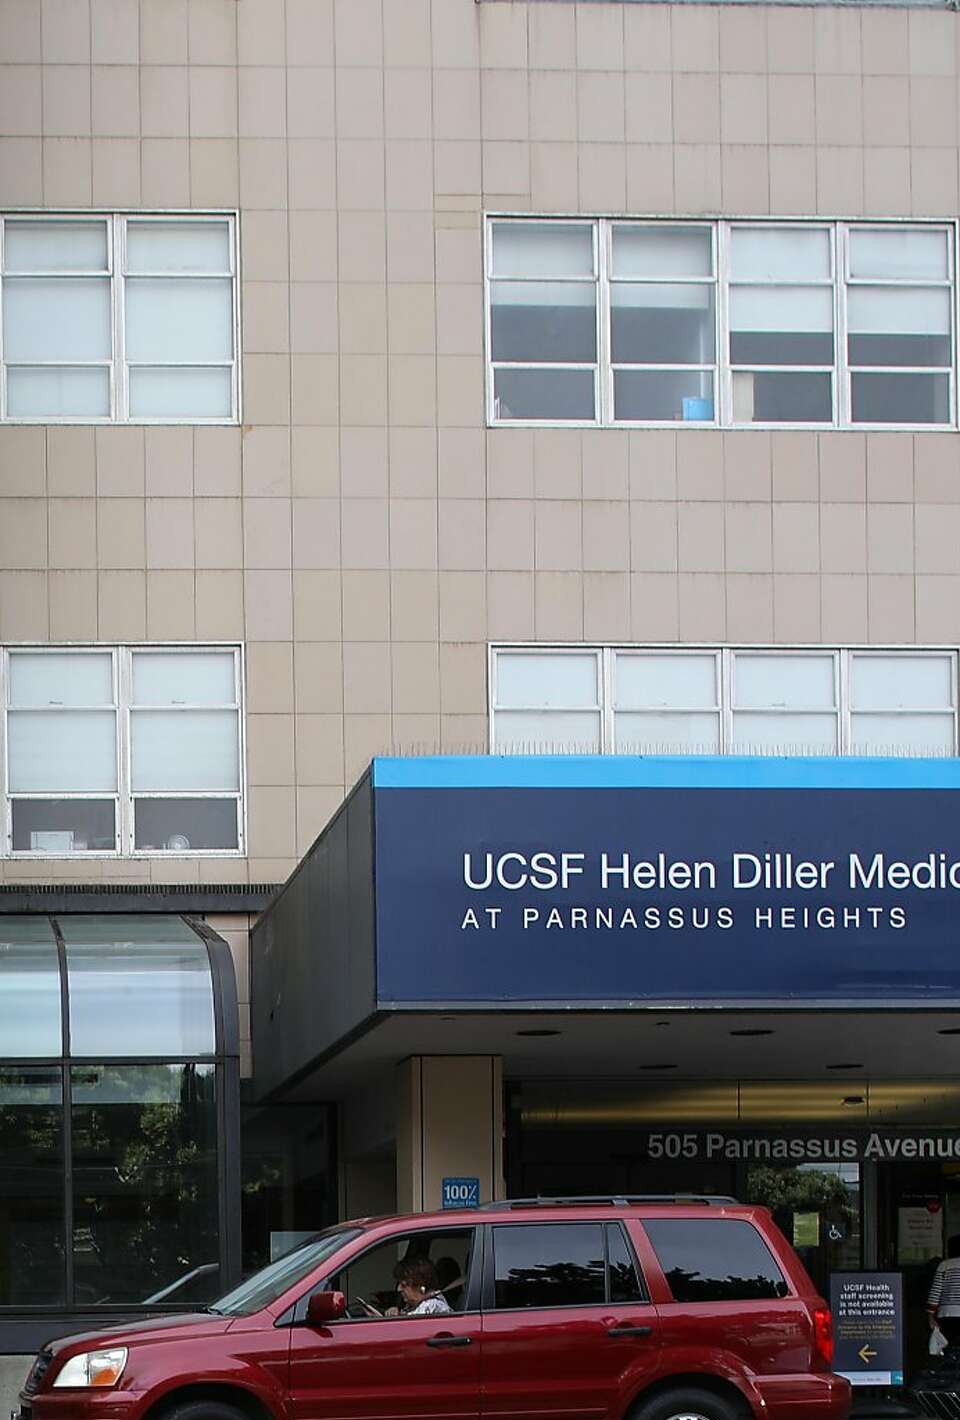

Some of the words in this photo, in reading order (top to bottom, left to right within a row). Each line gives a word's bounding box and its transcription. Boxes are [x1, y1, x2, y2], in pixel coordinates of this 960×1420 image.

[463, 852, 585, 890] UCSF
[600, 852, 716, 890] Helen
[732, 852, 835, 890] Diller
[461, 907, 502, 930] AT
[523, 906, 735, 930] PARNASSUS
[754, 906, 907, 930] HEIGHTS
[646, 1134, 699, 1159] 505
[705, 1133, 859, 1159] Parnassus
[444, 1184, 477, 1200] 100%
[843, 1283, 865, 1292] UCSF
[866, 1283, 890, 1292] Health
[840, 1292, 857, 1300] staff
[858, 1292, 894, 1301] screening
[862, 1300, 894, 1308] available
